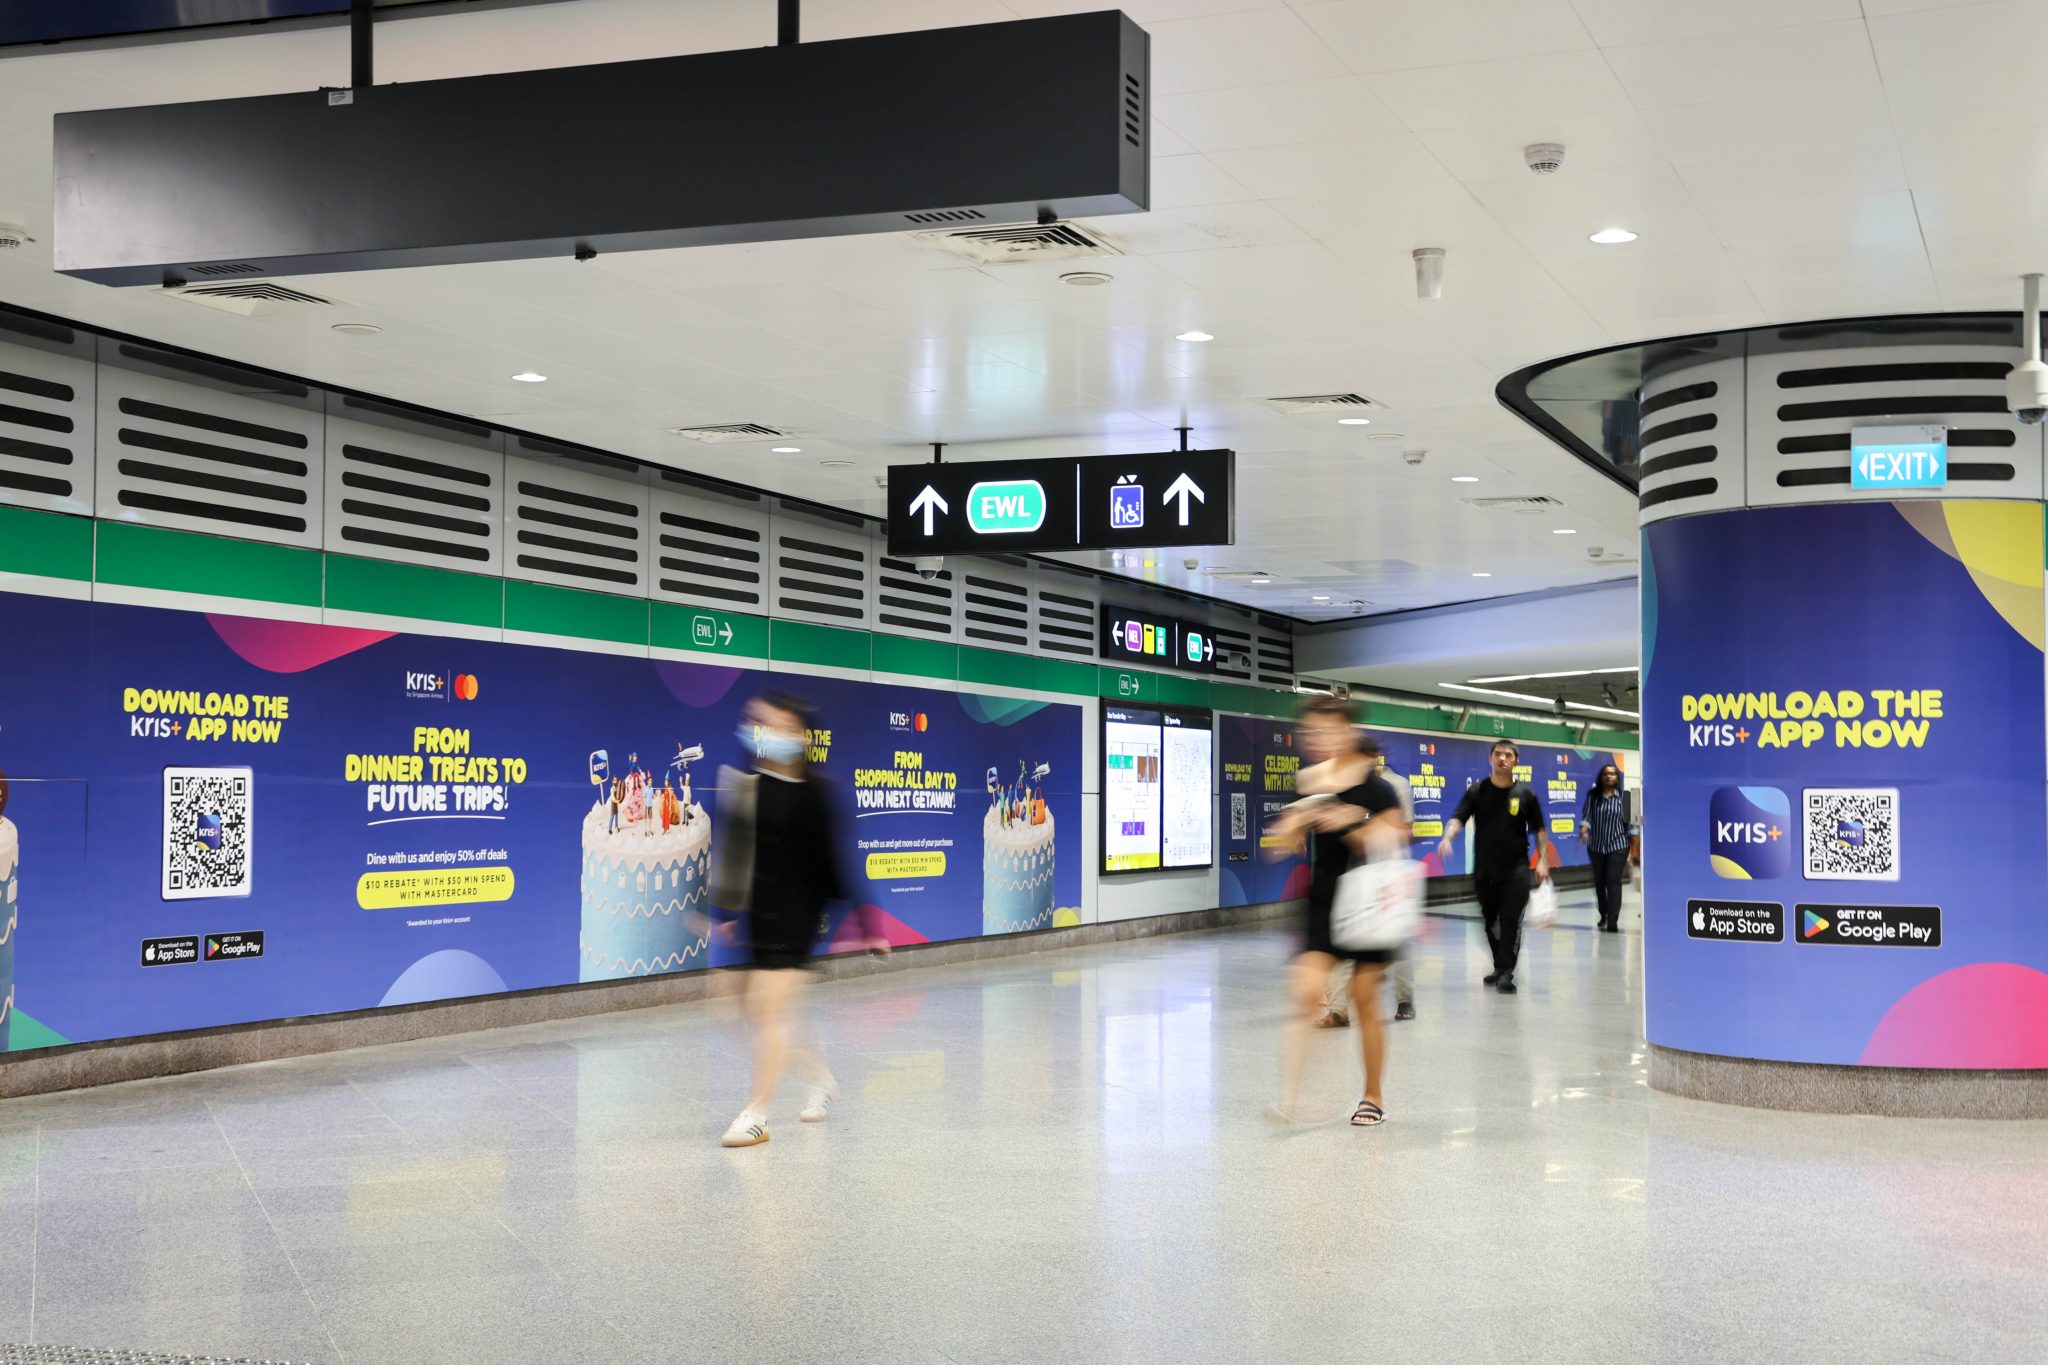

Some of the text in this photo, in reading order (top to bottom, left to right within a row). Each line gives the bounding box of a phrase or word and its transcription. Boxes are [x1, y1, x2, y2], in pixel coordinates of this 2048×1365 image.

[1870, 452, 1927, 481] EXIT
[981, 496, 1031, 519] EWL
[697, 624, 712, 637] EWL
[124, 687, 289, 719] DOWNLOAD THE
[1682, 689, 1943, 721] DOWNLOAD THE
[186, 717, 227, 741] APP
[231, 719, 282, 743] NOW
[814, 729, 831, 746] THE
[1757, 720, 1825, 748] APP
[1835, 720, 1930, 748] NOW
[413, 726, 470, 754] FROM
[345, 753, 527, 783] DINNER TREATS TO
[894, 751, 922, 769] FROM
[1265, 755, 1300, 772] CELEBRATE
[854, 769, 956, 790] SHOPPING ALL DAY TO
[1264, 774, 1281, 791] WITH
[367, 784, 508, 812] FUTURE TRIPS!
[856, 789, 956, 808] YOUR NEXT GETAWAY!
[858, 840, 869, 850] Shop
[869, 840, 880, 848] with
[367, 848, 508, 865] Dine with us and enjoy 50% off deals
[366, 880, 381, 889] $10
[424, 878, 444, 886] WITH
[447, 876, 461, 885] $50
[464, 876, 478, 884] MIN
[481, 874, 506, 883] SPEND
[400, 888, 477, 900] WITH MASTERCARD
[1709, 907, 1770, 919] Download on the
[1837, 909, 1882, 921] GET IT ON
[1709, 919, 1775, 935] App Store
[1837, 921, 1932, 942] Google Play
[157, 948, 195, 961] App Store
[221, 942, 260, 955] Google Play
